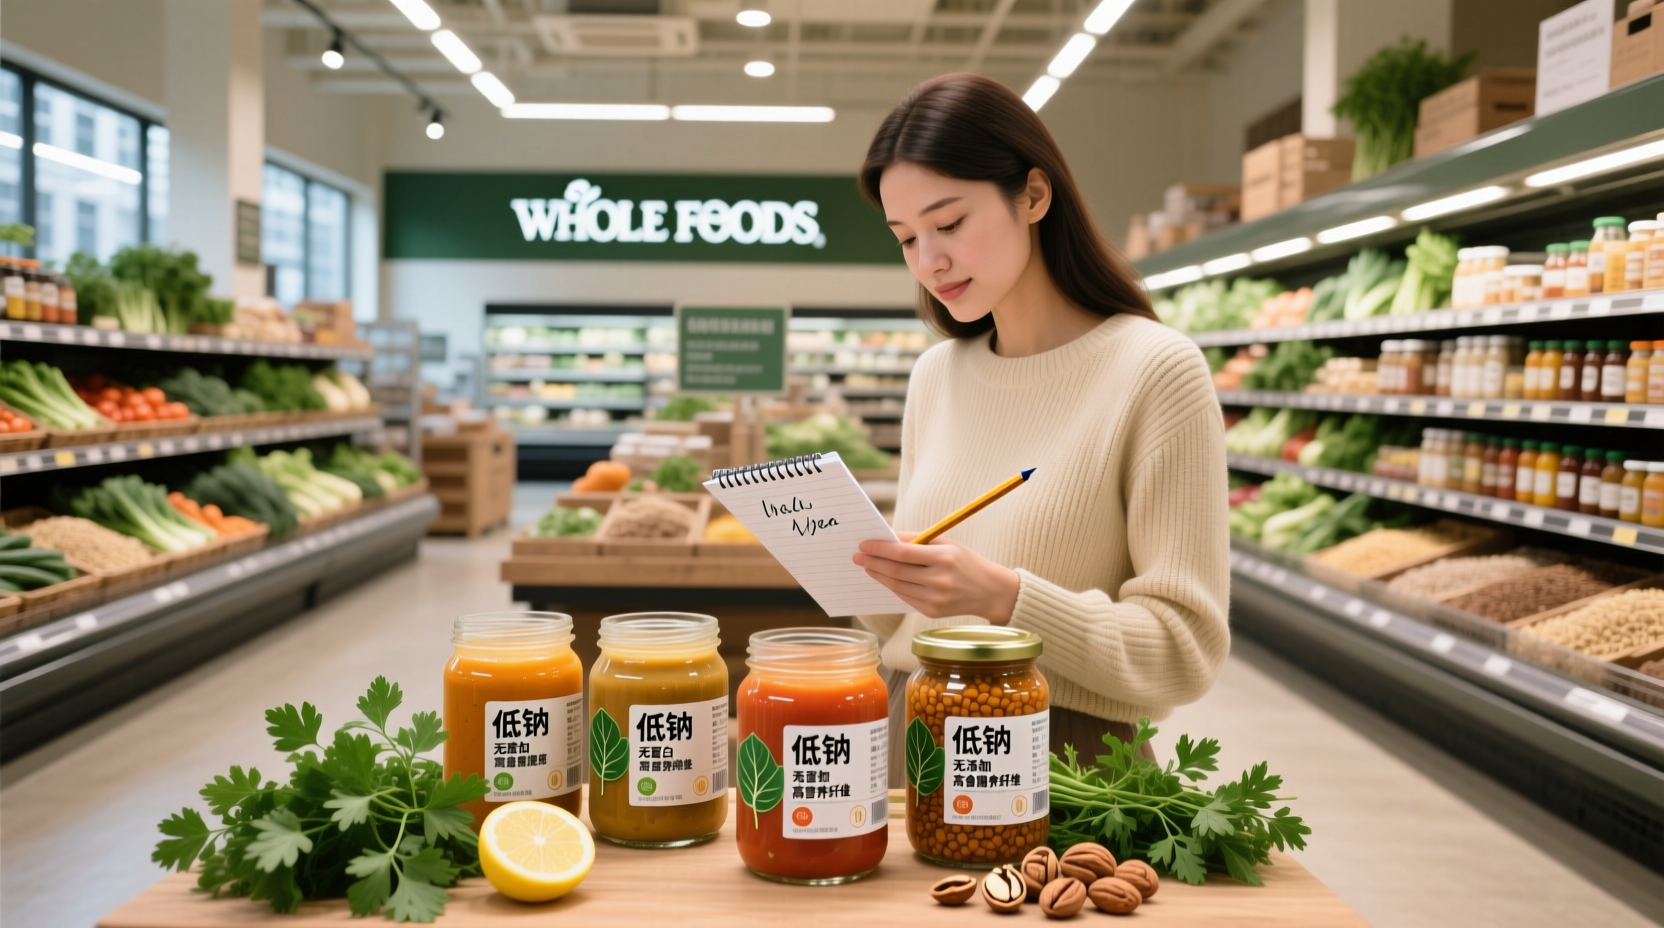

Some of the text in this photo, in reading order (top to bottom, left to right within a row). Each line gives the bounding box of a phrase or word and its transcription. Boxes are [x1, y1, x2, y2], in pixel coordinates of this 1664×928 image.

[510, 179, 820, 244] WHOLE FOODS
[492, 706, 549, 739] 低钠
[636, 711, 693, 742] 低钠
[791, 733, 851, 766] 低钠
[951, 724, 1011, 756] 低钠
